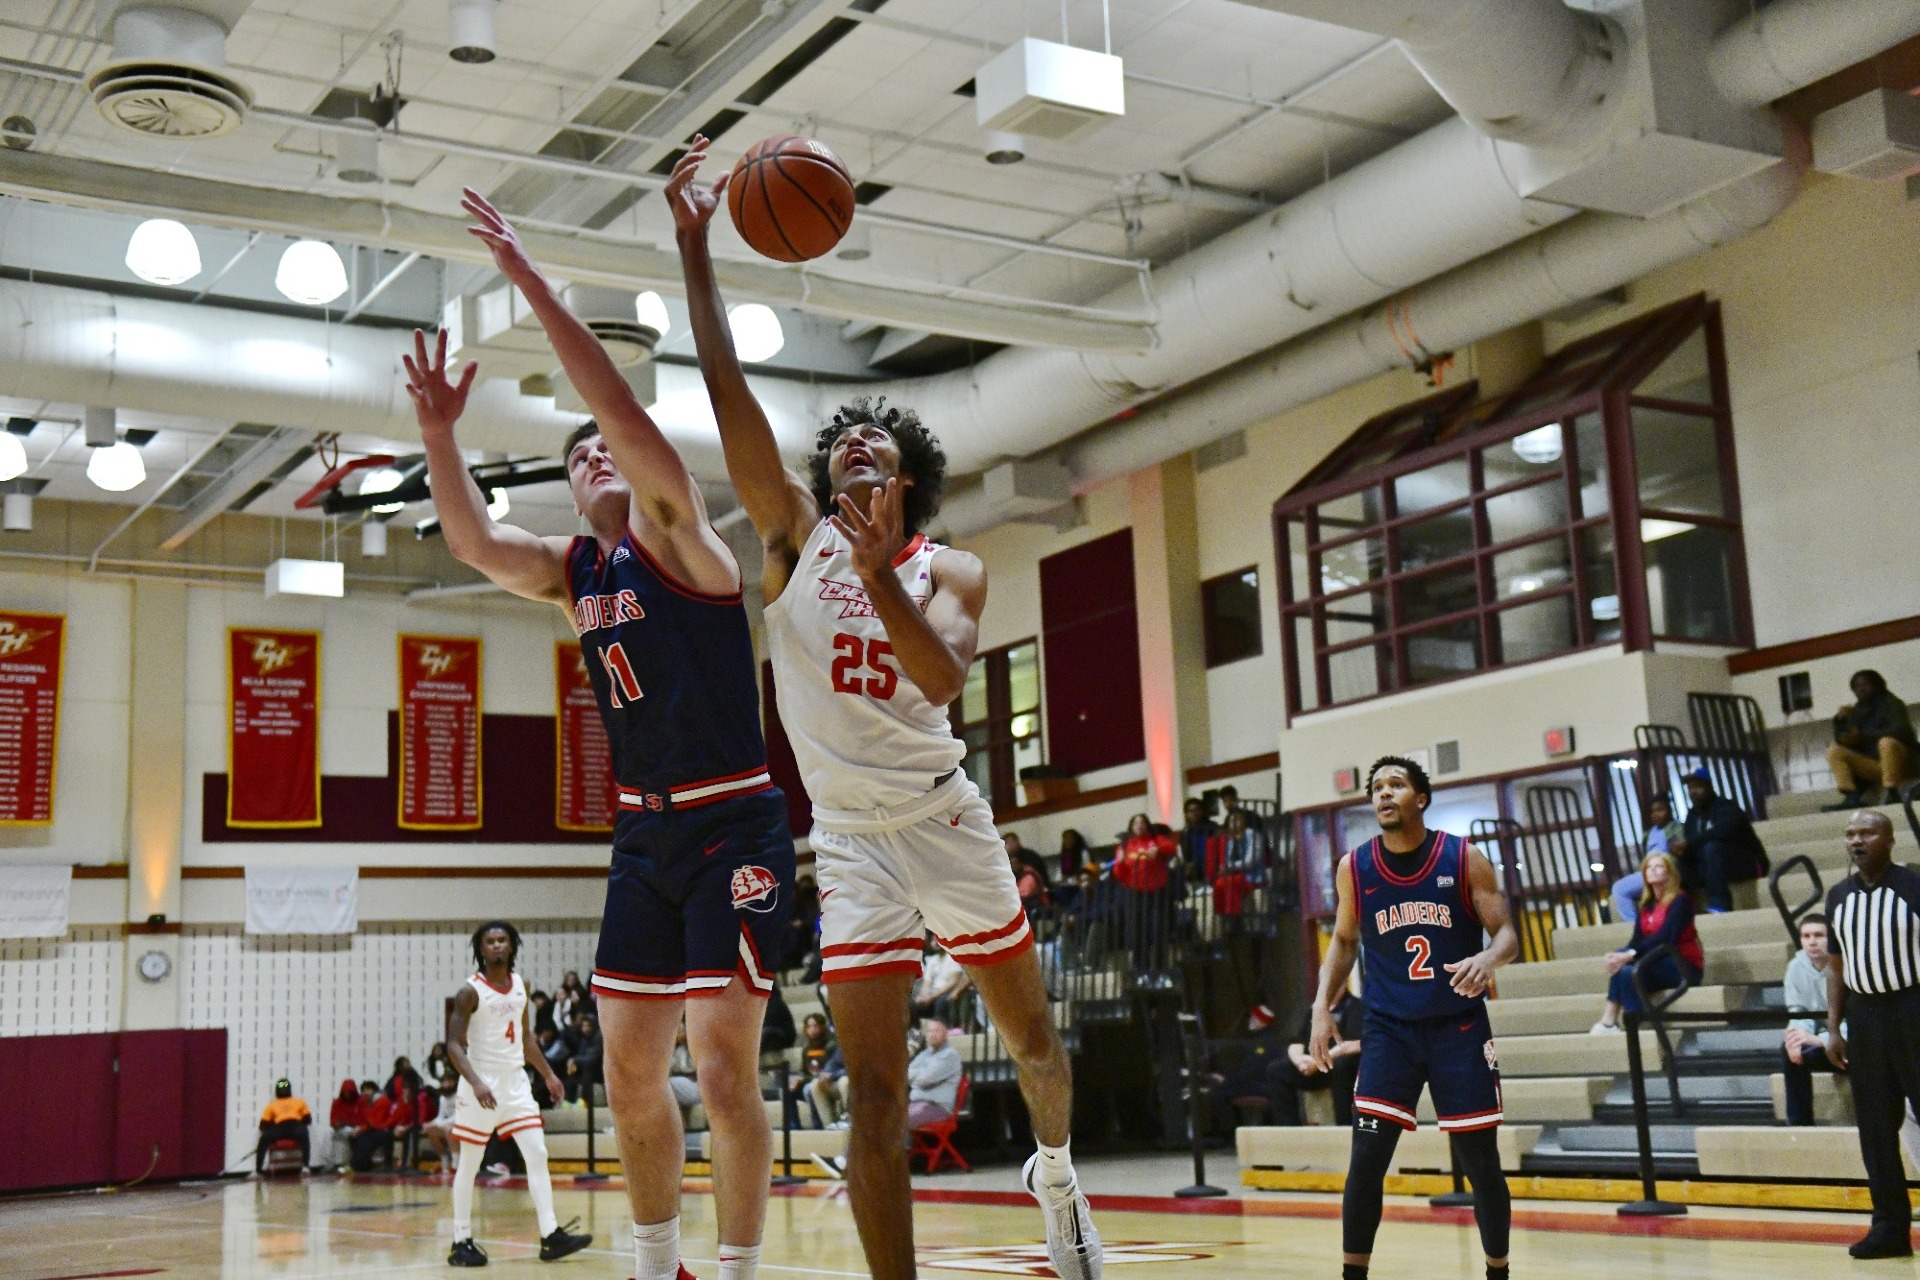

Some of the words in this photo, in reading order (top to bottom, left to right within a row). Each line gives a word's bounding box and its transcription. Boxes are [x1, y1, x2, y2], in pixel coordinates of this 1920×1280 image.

[831, 632, 898, 701] 25
[1375, 901, 1452, 935] RAIDERS
[1405, 935, 1434, 980] 2
[505, 1020, 515, 1044] 4
